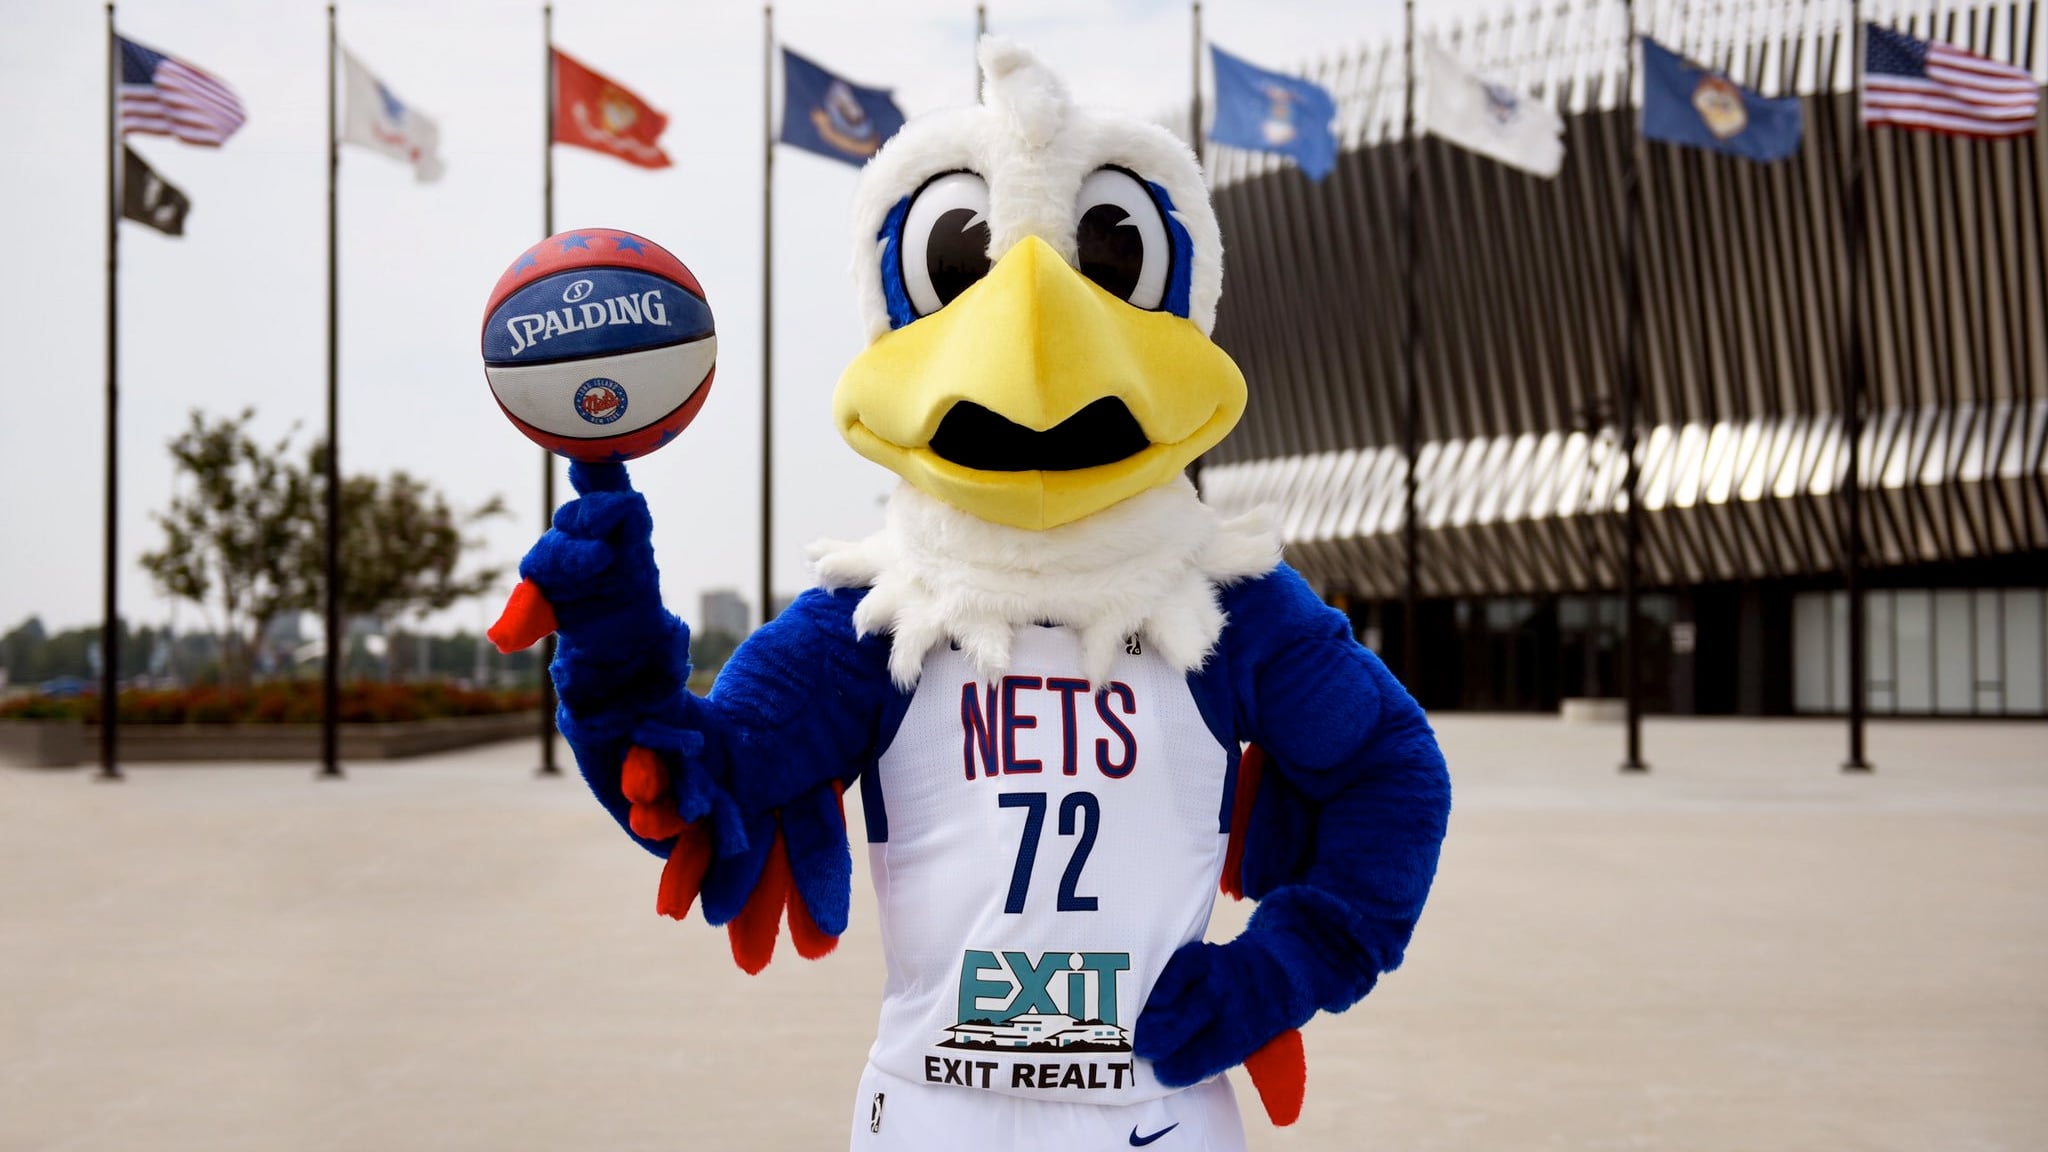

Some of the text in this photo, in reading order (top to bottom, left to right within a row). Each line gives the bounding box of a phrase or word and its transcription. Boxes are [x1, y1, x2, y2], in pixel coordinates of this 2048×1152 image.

[506, 290, 667, 356] SPALDING
[961, 675, 1138, 781] NETS
[998, 791, 1100, 914] 72
[925, 1055, 1135, 1089] EXIT REALT
